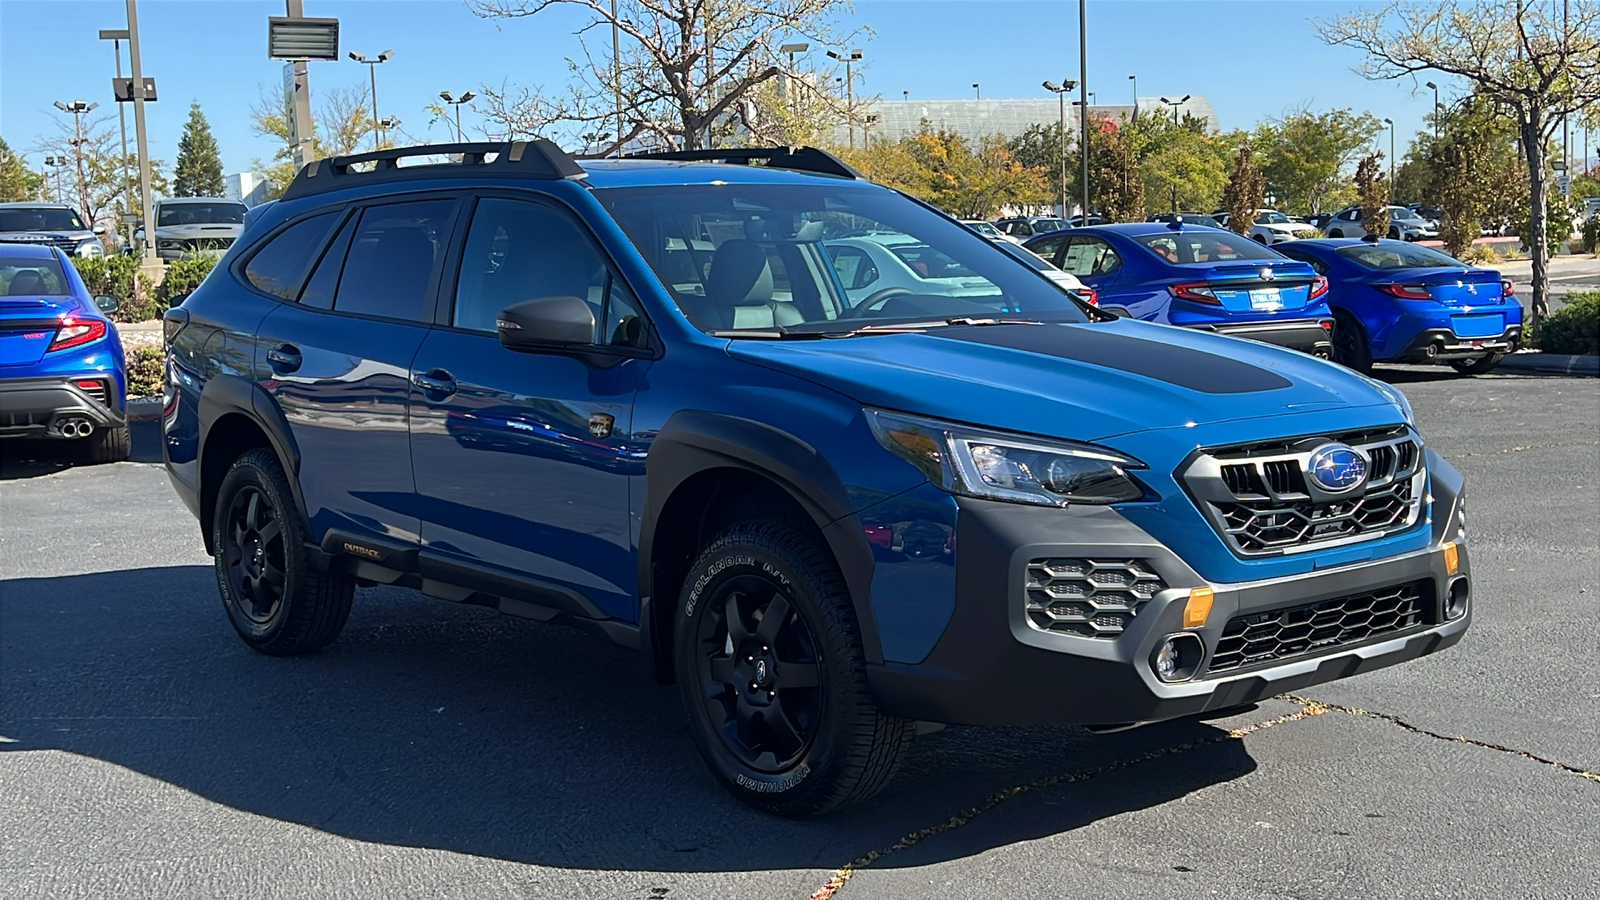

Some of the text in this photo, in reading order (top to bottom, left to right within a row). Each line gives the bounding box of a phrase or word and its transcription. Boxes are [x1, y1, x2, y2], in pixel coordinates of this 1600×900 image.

[344, 542, 381, 559] OUTBACK
[685, 555, 790, 617] GEOLANDAR A/T
[736, 764, 811, 793] YOKOHAMA
